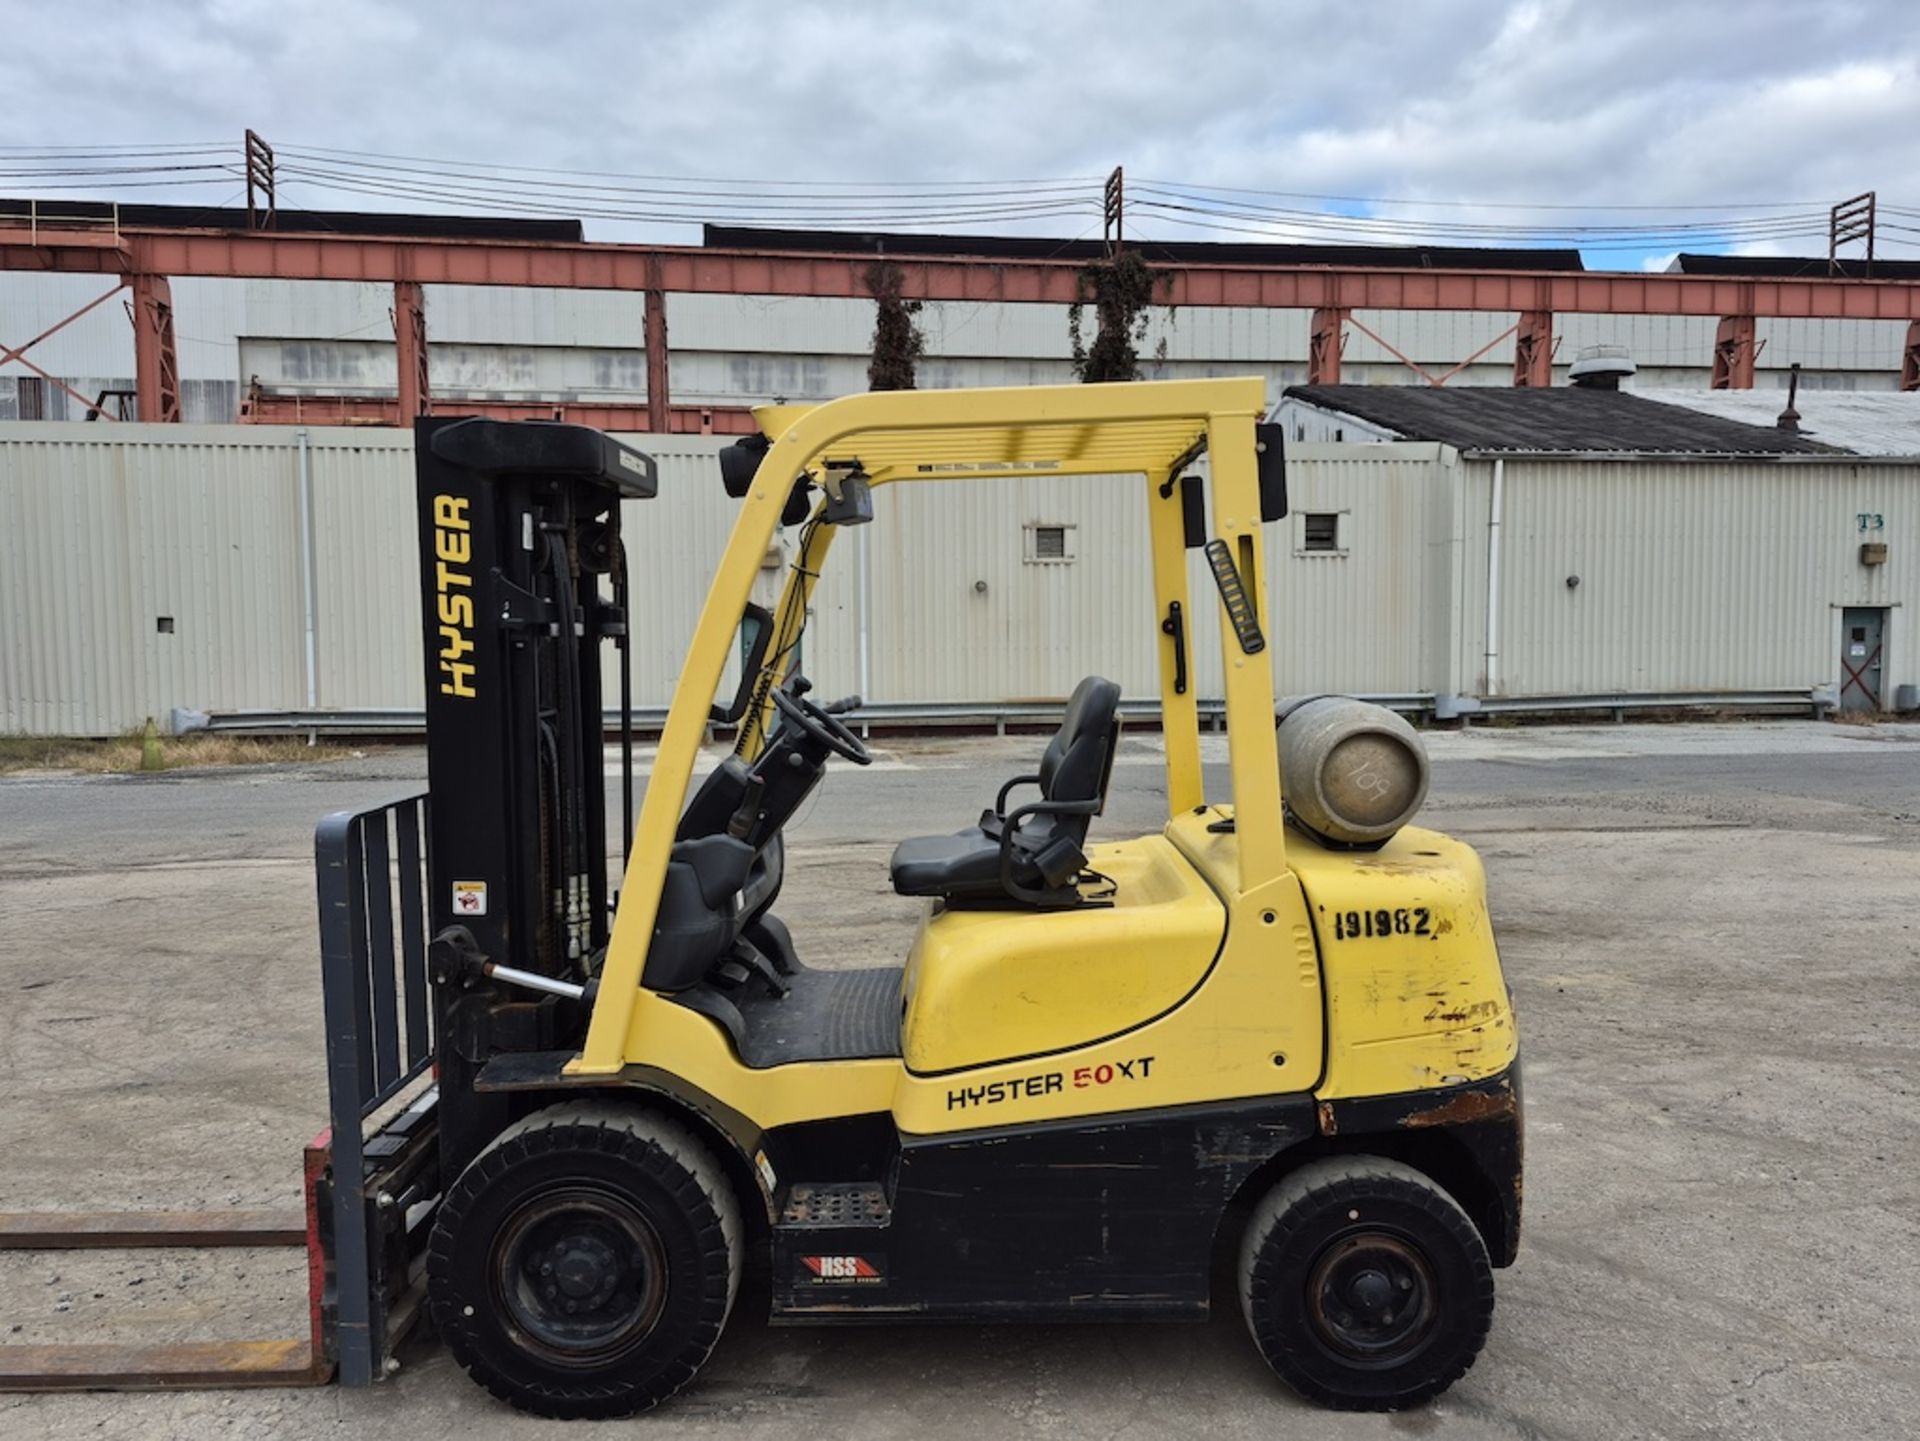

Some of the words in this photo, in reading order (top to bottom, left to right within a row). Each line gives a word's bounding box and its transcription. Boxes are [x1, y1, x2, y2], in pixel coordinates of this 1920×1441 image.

[1857, 513, 1884, 530] T3
[434, 495, 476, 698] HYSTER
[1335, 907, 1431, 940] 191982
[947, 1072, 1064, 1111] HYSTER
[820, 1256, 857, 1276] HSS
